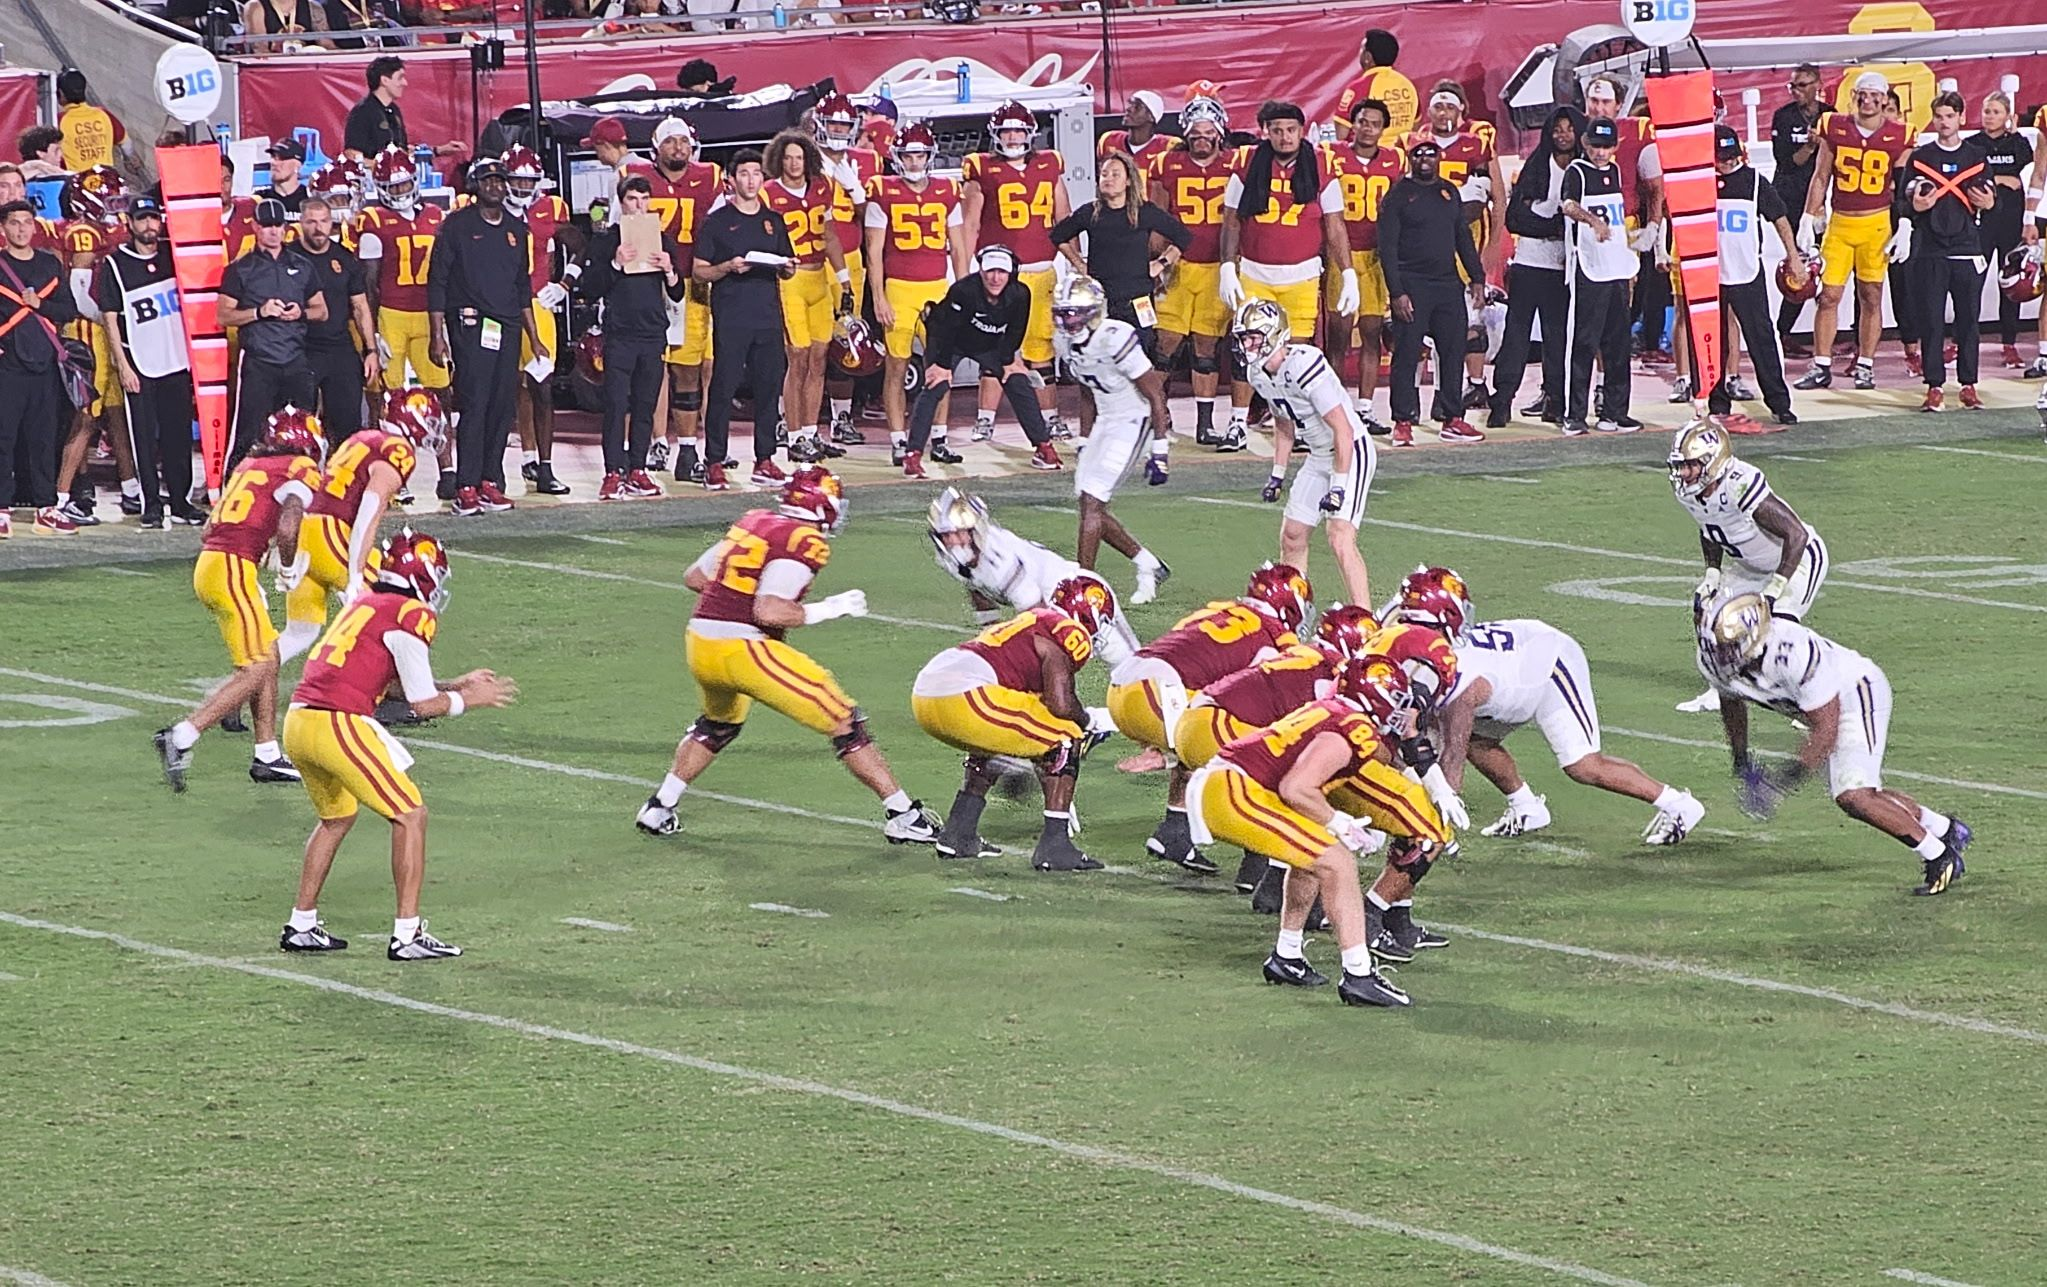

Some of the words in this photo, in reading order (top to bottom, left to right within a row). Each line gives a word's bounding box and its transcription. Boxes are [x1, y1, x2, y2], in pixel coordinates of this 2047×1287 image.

[1384, 88, 1411, 101] CSC
[75, 120, 104, 136] CSC
[80, 147, 107, 162] STAFF
[1835, 145, 1891, 195] 58
[996, 181, 1054, 230] 64
[1177, 176, 1231, 225] 52
[1340, 173, 1391, 222] 80
[645, 198, 694, 243] 71
[783, 204, 826, 257] 29
[890, 203, 943, 251] 53
[72, 230, 95, 252] 19
[395, 234, 436, 286] 17
[1284, 370, 1292, 384] C
[1272, 398, 1305, 429] 7
[1697, 429, 1720, 445] W
[388, 445, 415, 476] 24
[1719, 492, 1728, 506] C
[1065, 629, 1092, 662] 60
[1348, 723, 1379, 759] 84
